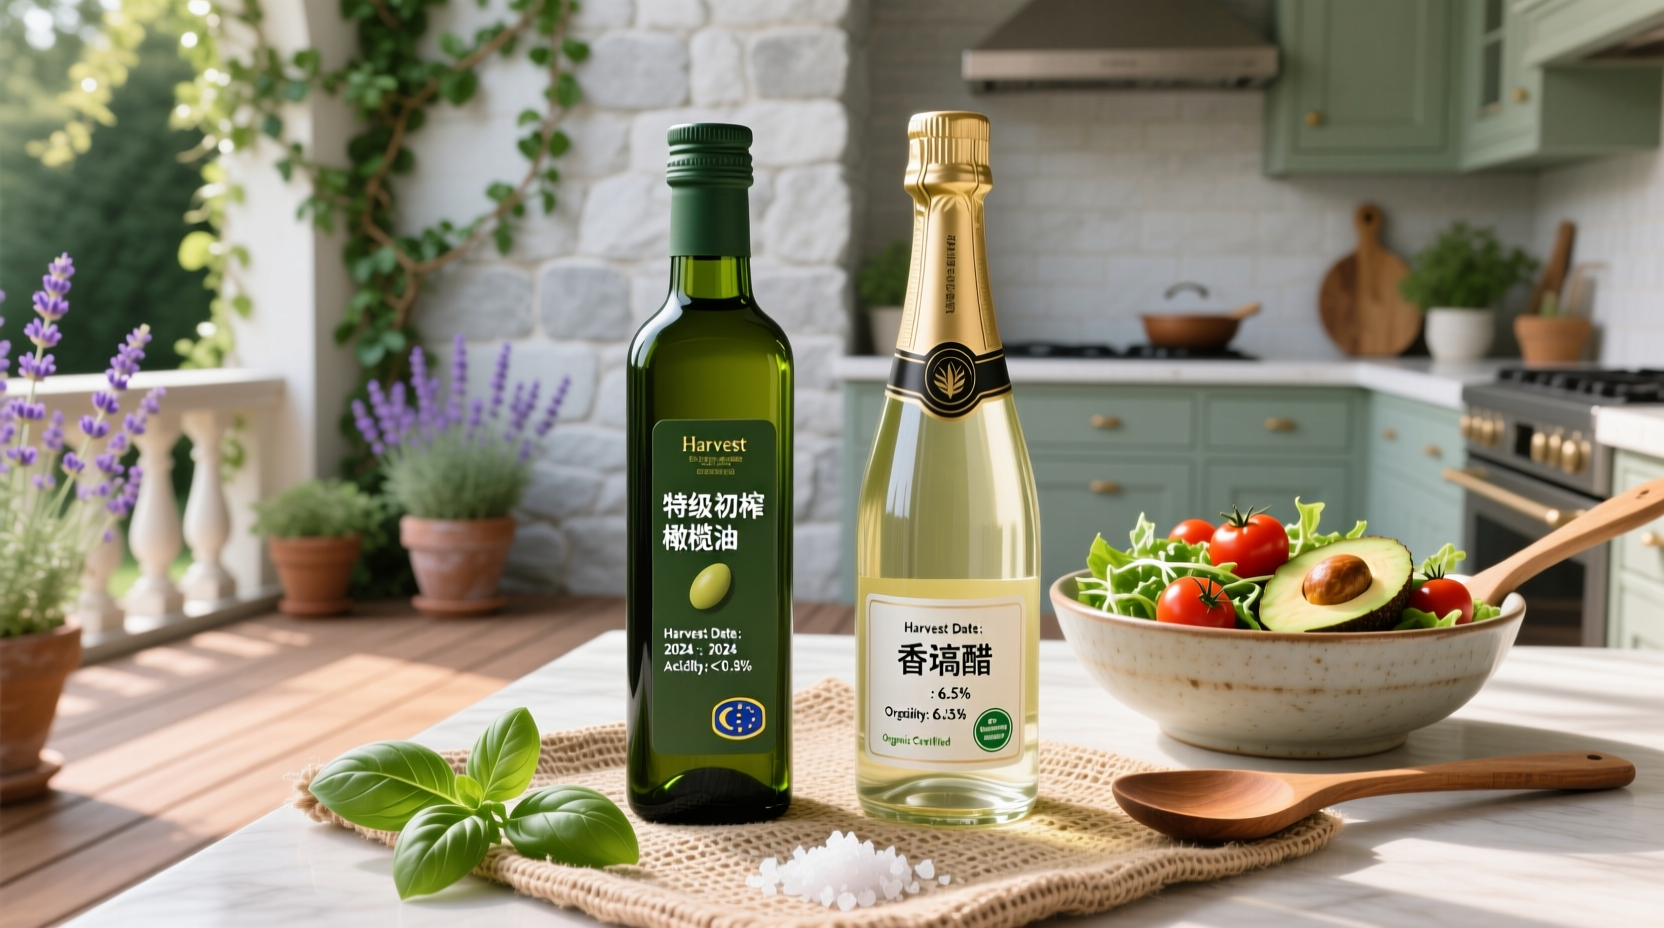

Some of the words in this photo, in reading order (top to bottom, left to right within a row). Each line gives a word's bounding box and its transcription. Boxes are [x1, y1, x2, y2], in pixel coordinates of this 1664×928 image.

[682, 435, 747, 452] Harvest
[662, 491, 765, 520] 特级初榨
[662, 522, 738, 551] 橄榄油
[904, 622, 948, 634] Harvest
[664, 643, 694, 655] 2024
